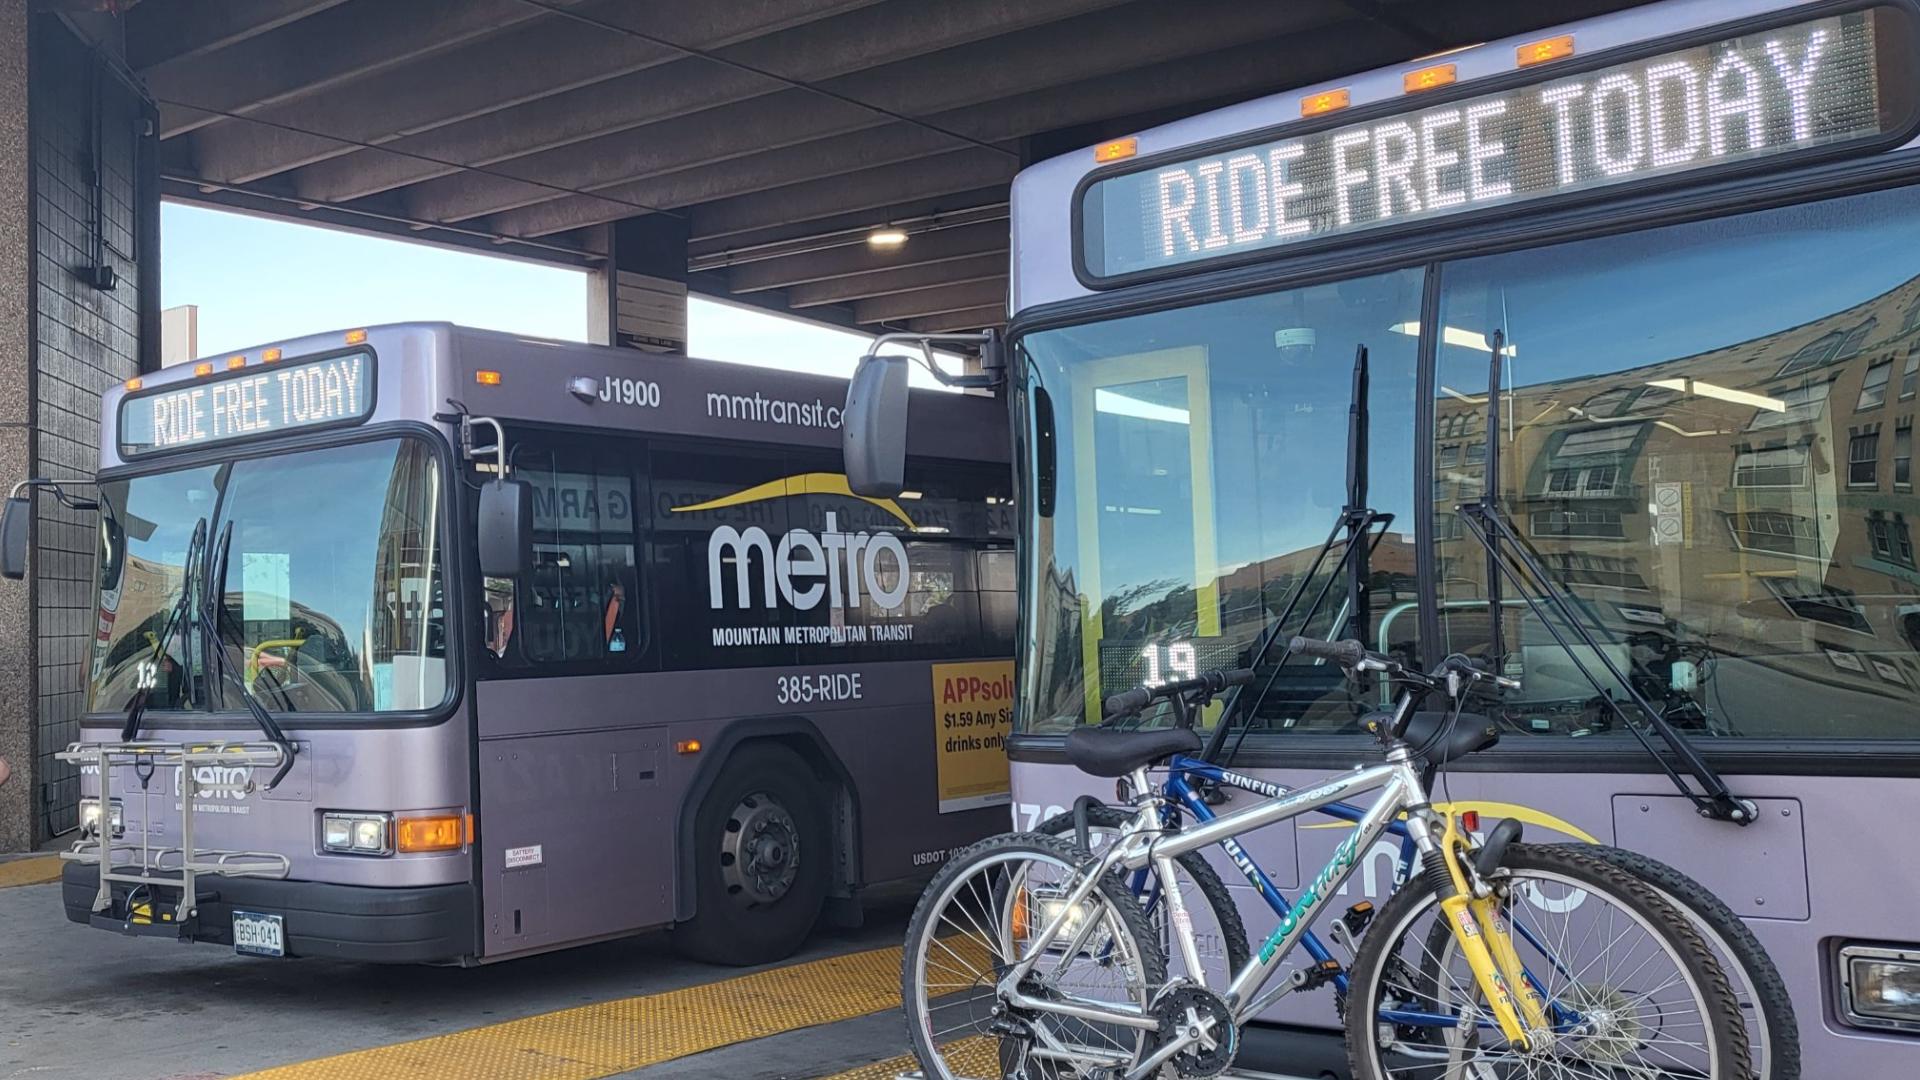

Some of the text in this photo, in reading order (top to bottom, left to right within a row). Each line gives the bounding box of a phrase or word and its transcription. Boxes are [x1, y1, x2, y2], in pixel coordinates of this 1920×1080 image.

[1156, 29, 1828, 257] RIDE FREE TODAY
[153, 358, 360, 447] RIDE FREE TODAY
[599, 376, 660, 408] J1900
[708, 511, 910, 611] metro
[712, 624, 914, 647] MOUNTAIN METROPOLITAN TRANSIT
[1142, 641, 1196, 689] 19
[777, 672, 862, 704] 385-RIDE
[944, 711, 973, 729] $1.59
[976, 710, 997, 728] Any
[945, 732, 1007, 753] drinks only
[1222, 771, 1288, 799] SUNFIRE
[913, 850, 946, 866] USDOT
[1223, 838, 1255, 876] UJI
